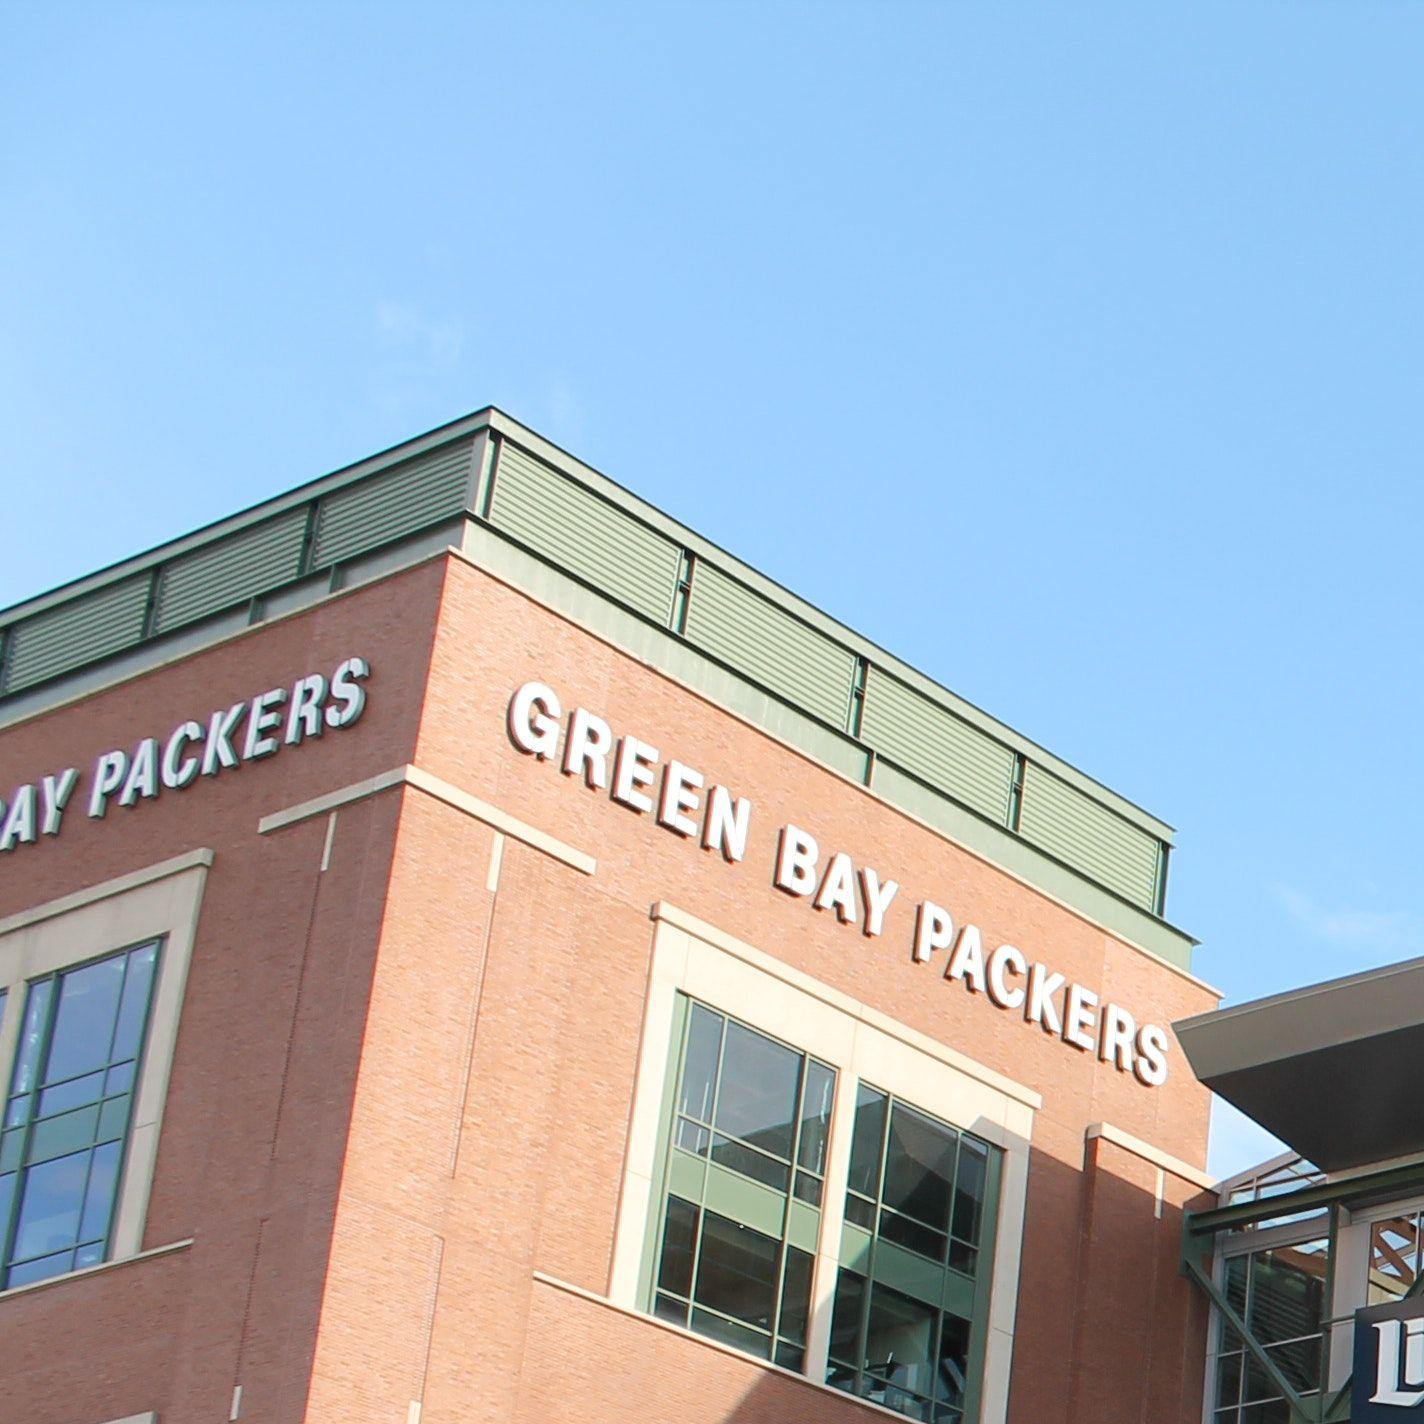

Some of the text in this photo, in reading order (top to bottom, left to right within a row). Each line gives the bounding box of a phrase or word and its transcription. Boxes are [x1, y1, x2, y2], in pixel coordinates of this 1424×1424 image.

[0, 657, 370, 850] AY PACKERS
[508, 681, 1168, 1087] GREEN BAY PACKERS
